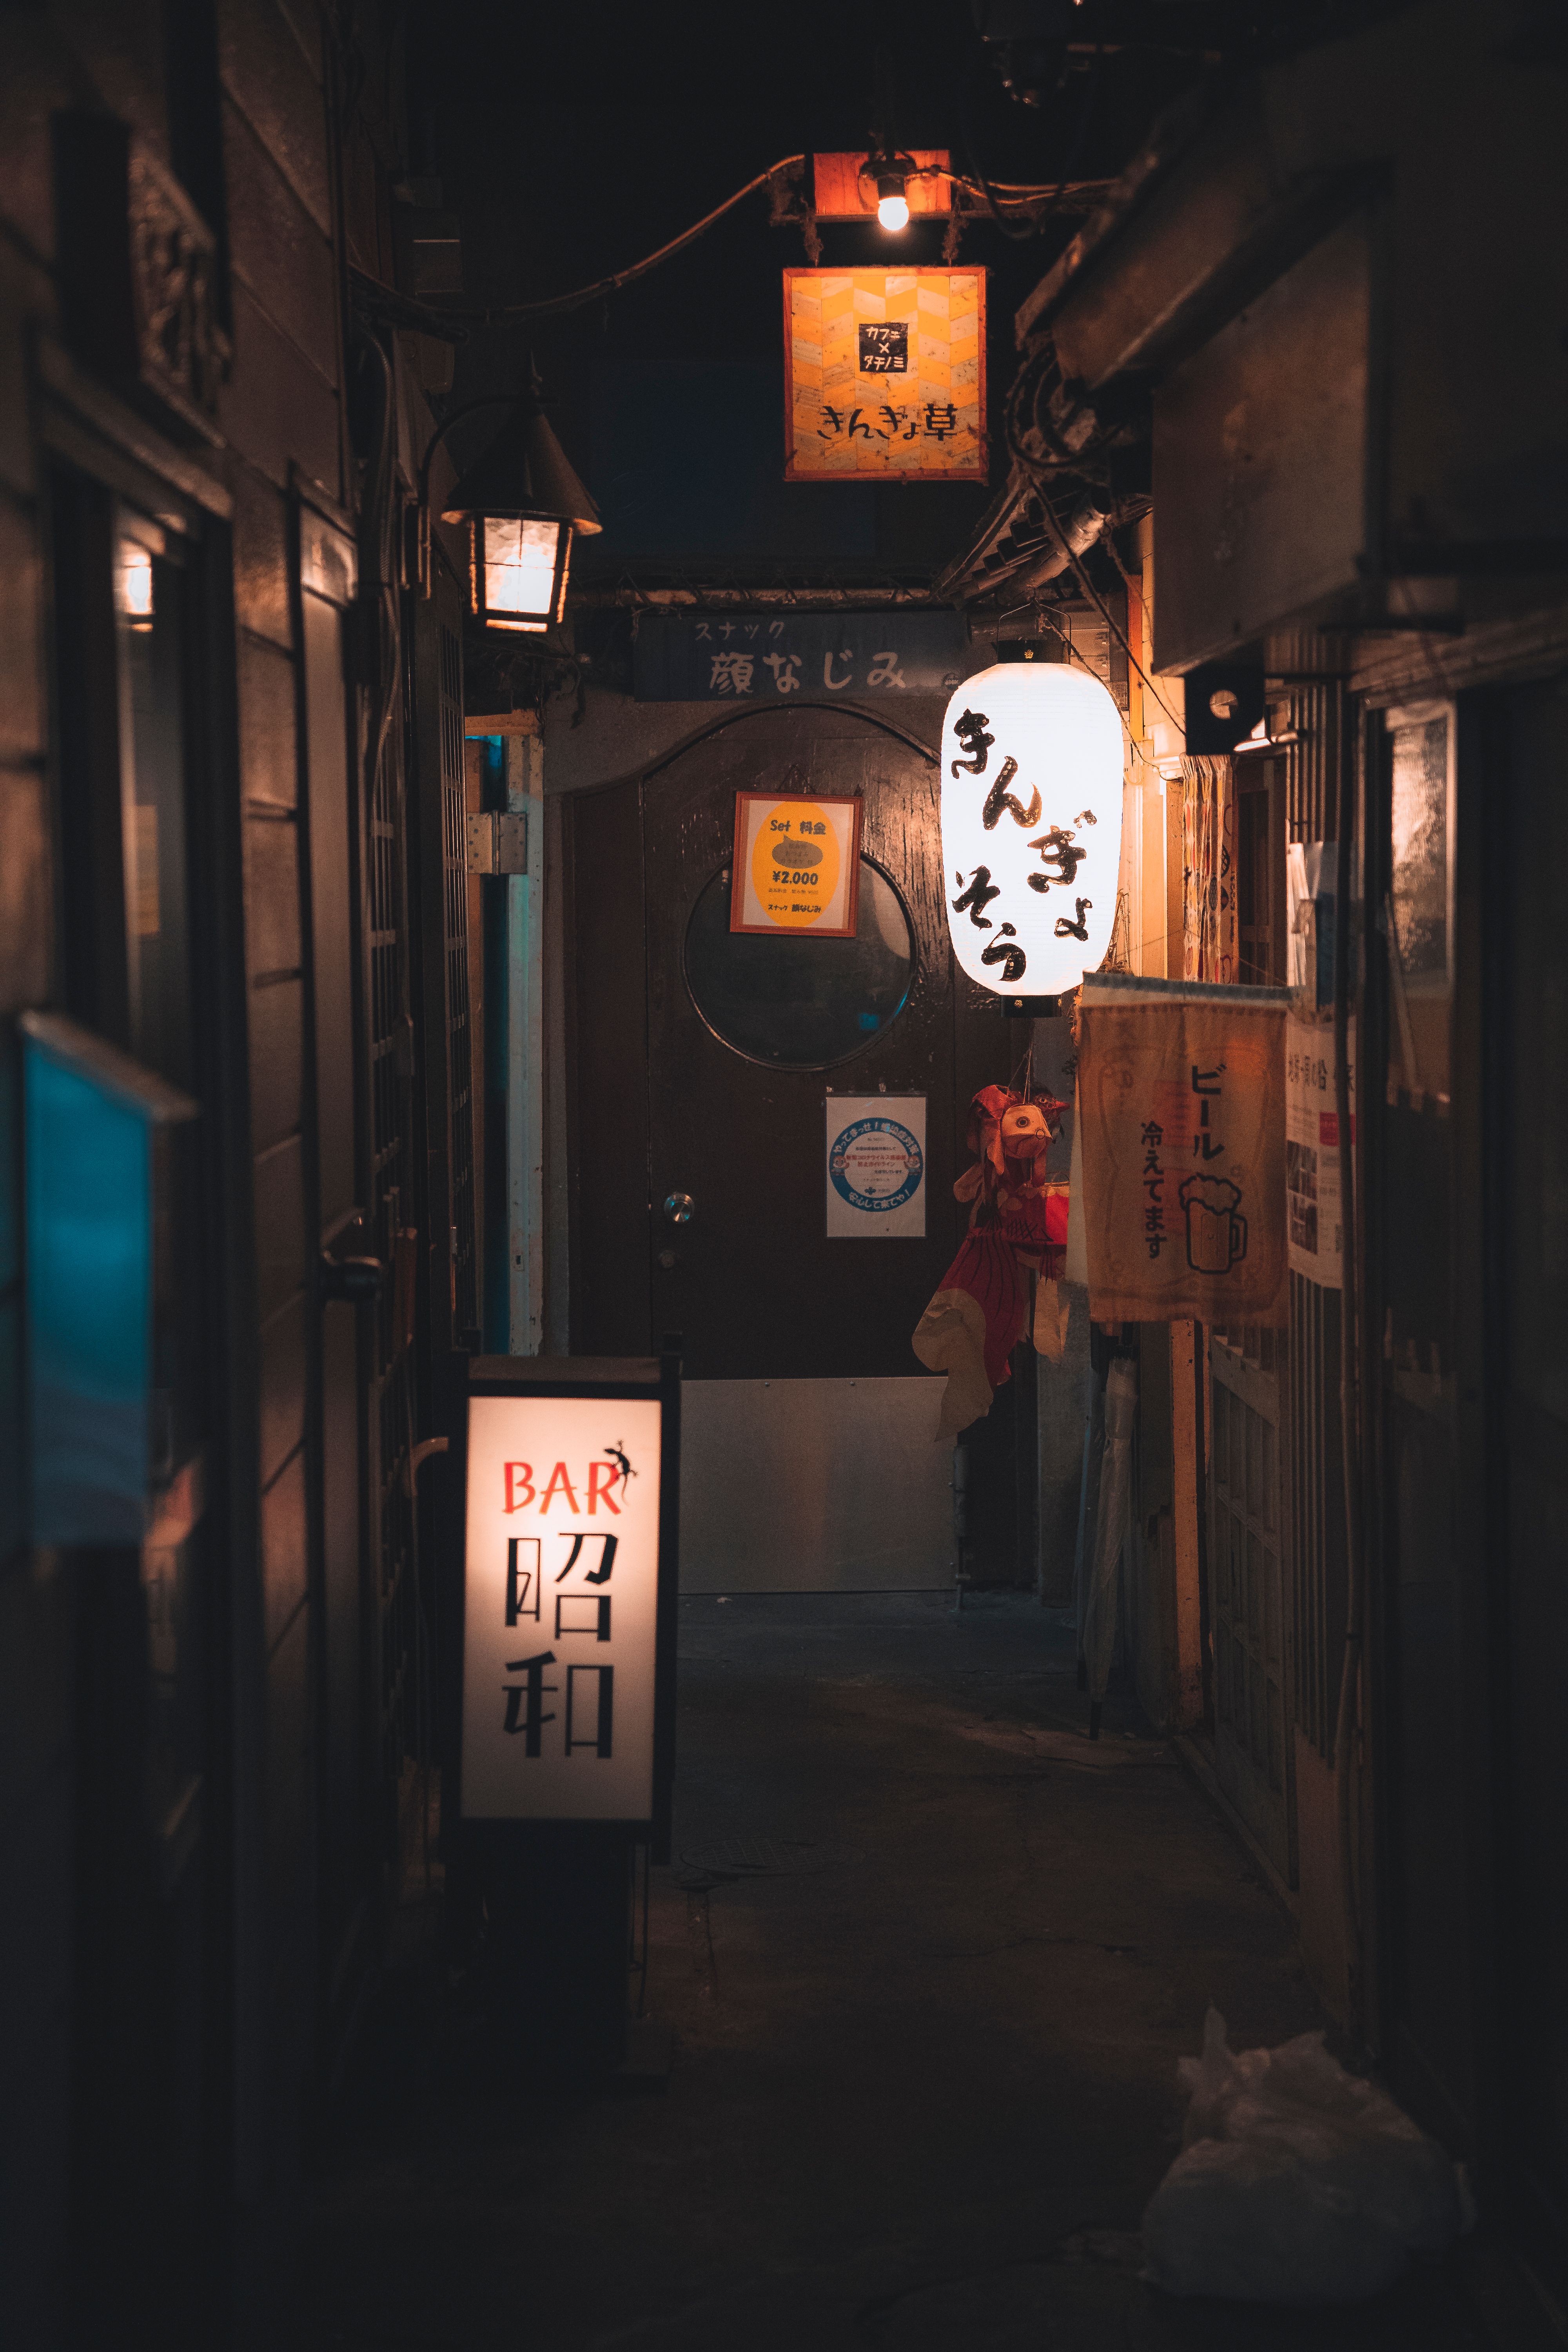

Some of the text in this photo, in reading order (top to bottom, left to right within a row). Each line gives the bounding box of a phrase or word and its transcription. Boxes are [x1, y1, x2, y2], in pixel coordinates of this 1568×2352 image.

[863, 356, 905, 370] タチノミ
[817, 403, 958, 441] きんぎょ草
[695, 621, 785, 641] スナック
[710, 649, 907, 695] 顔なじみ
[769, 819, 826, 835] Set 料金
[1191, 1063, 1228, 1161] ビール
[1140, 1120, 1167, 1259] 冷えてます
[501, 1461, 621, 1515] BAR
[501, 1532, 620, 1759] 昭和
